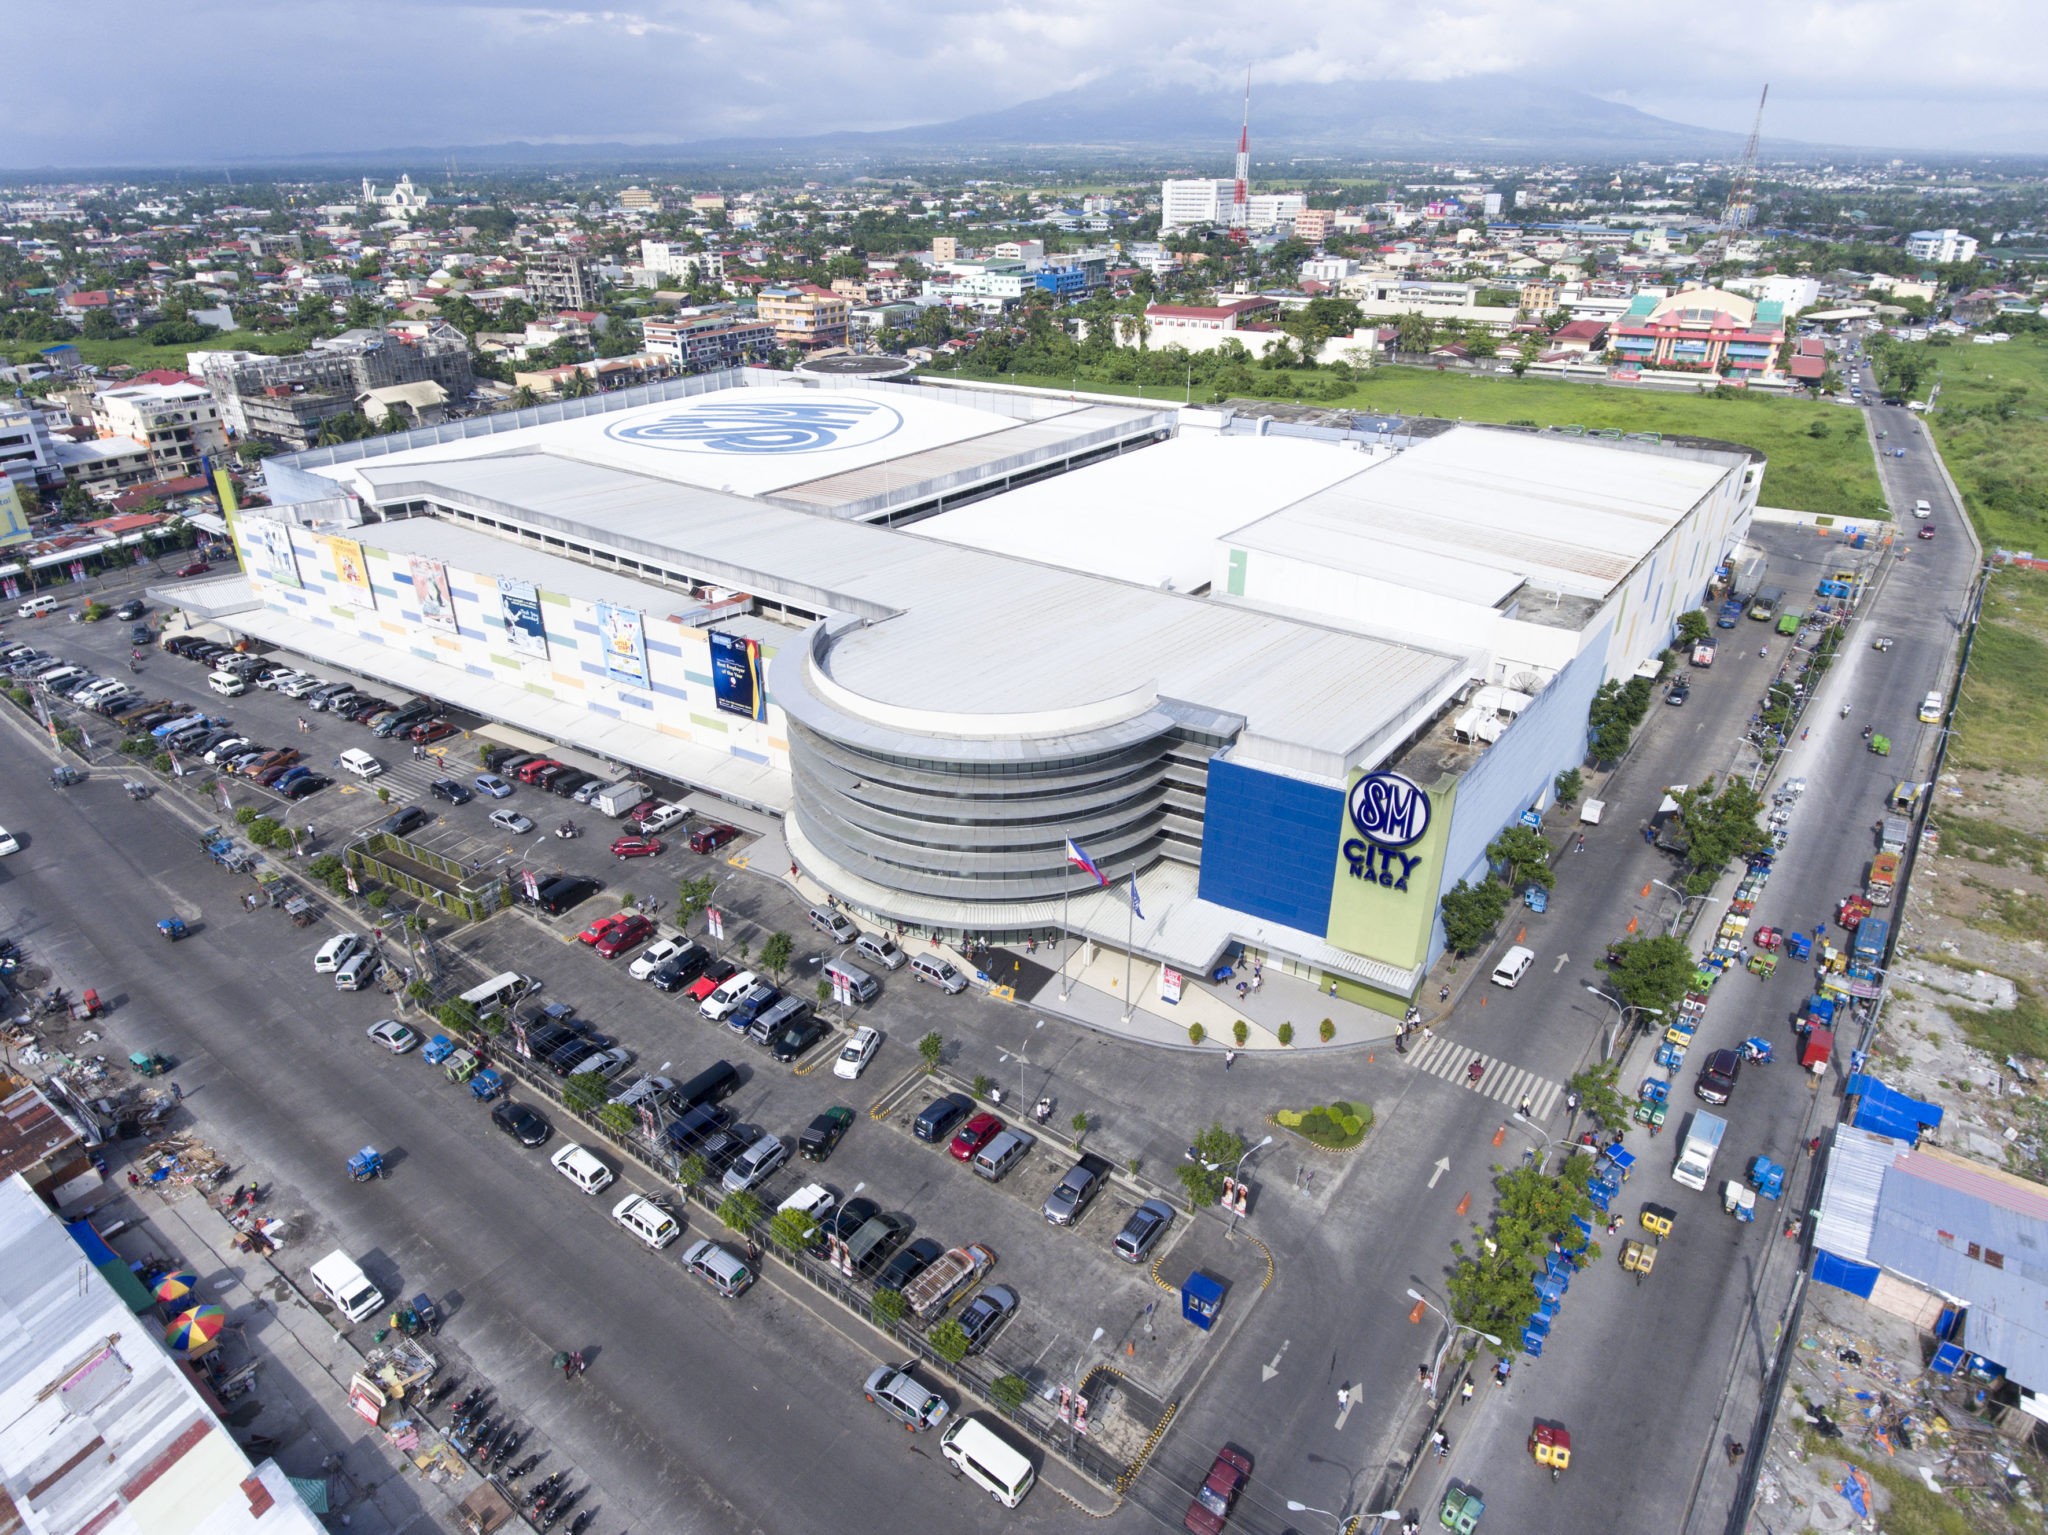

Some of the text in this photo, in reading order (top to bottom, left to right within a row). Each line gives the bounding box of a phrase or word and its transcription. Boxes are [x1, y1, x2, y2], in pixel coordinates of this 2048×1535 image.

[1356, 776, 1420, 841] SM
[1343, 838, 1422, 881] CITY
[1349, 863, 1409, 893] NAGA
